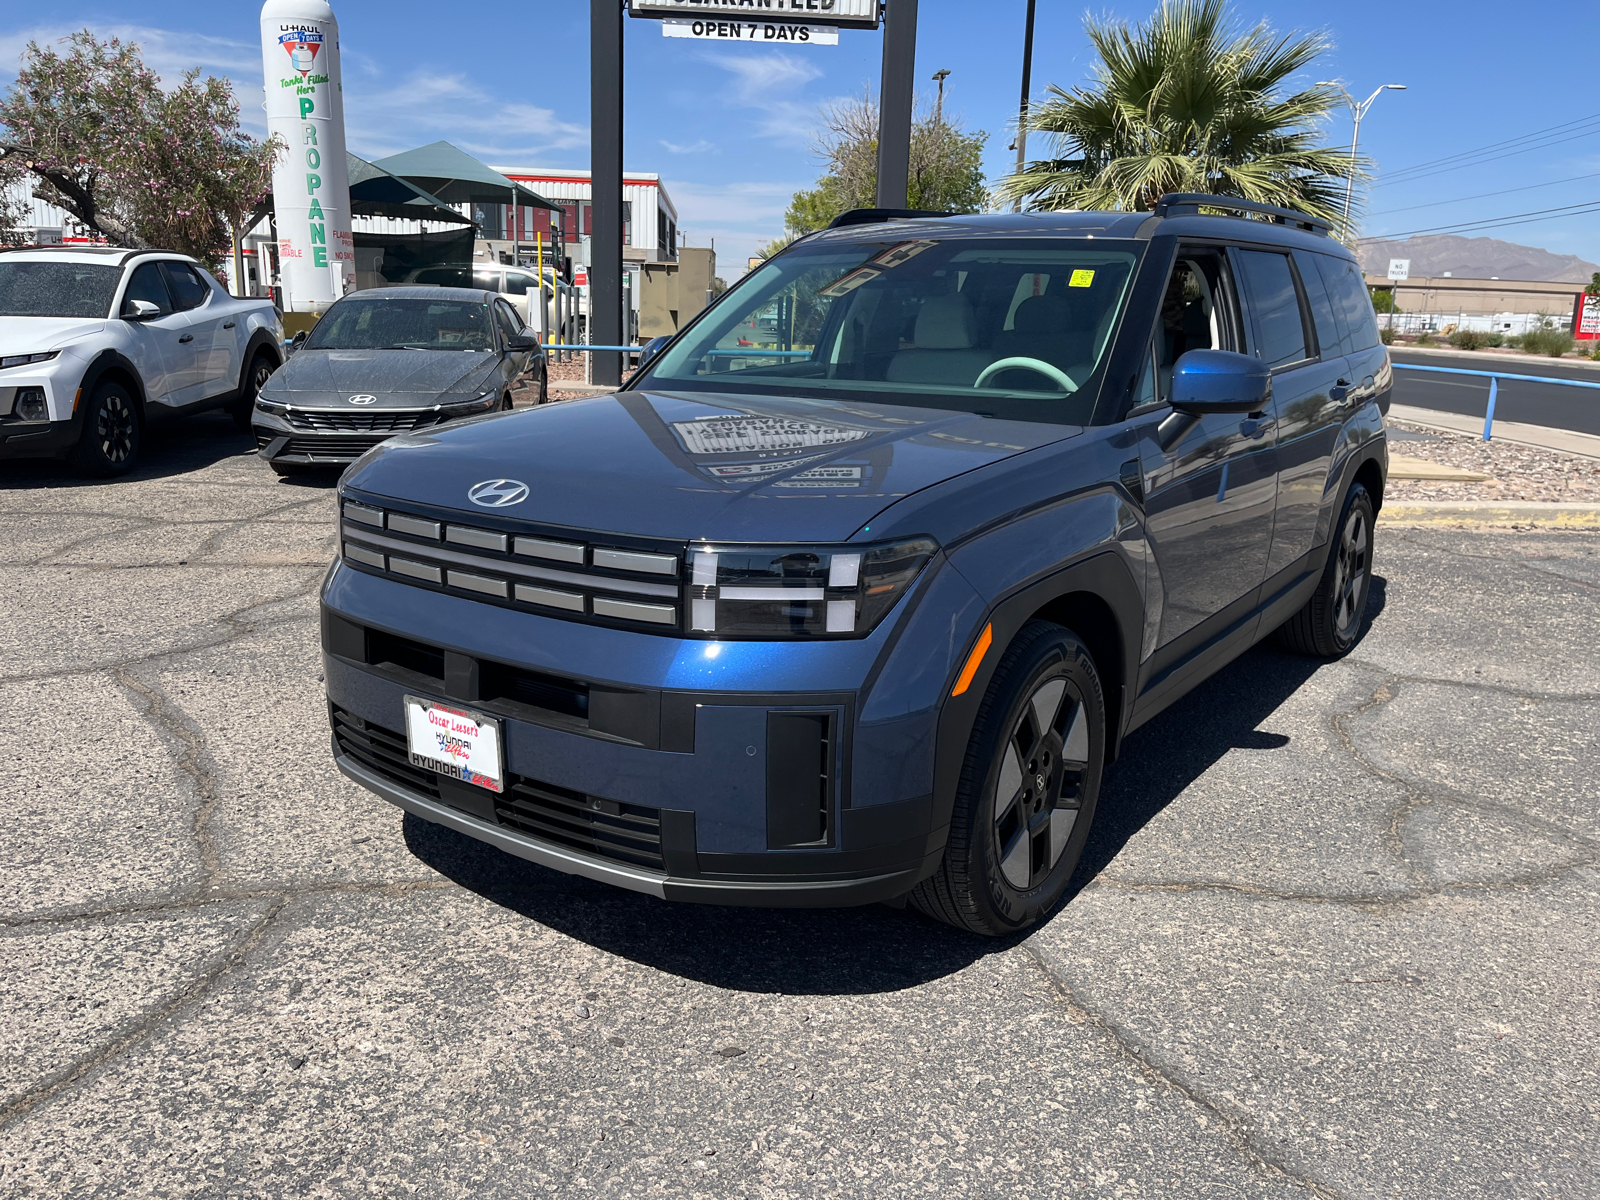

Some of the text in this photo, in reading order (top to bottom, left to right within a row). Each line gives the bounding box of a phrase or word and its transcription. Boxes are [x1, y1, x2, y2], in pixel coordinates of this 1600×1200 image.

[280, 25, 320, 33] U-HAUL
[282, 33, 299, 42] OPEN
[691, 21, 810, 41] OPEN 7 DAYS
[280, 74, 329, 88] Tanks Filled
[296, 86, 316, 95] Here
[299, 97, 328, 267] PROPANE
[428, 710, 479, 738] Oscar Leeser's
[435, 731, 472, 750] HYUNDAI
[412, 753, 461, 778] HYUNDAI
